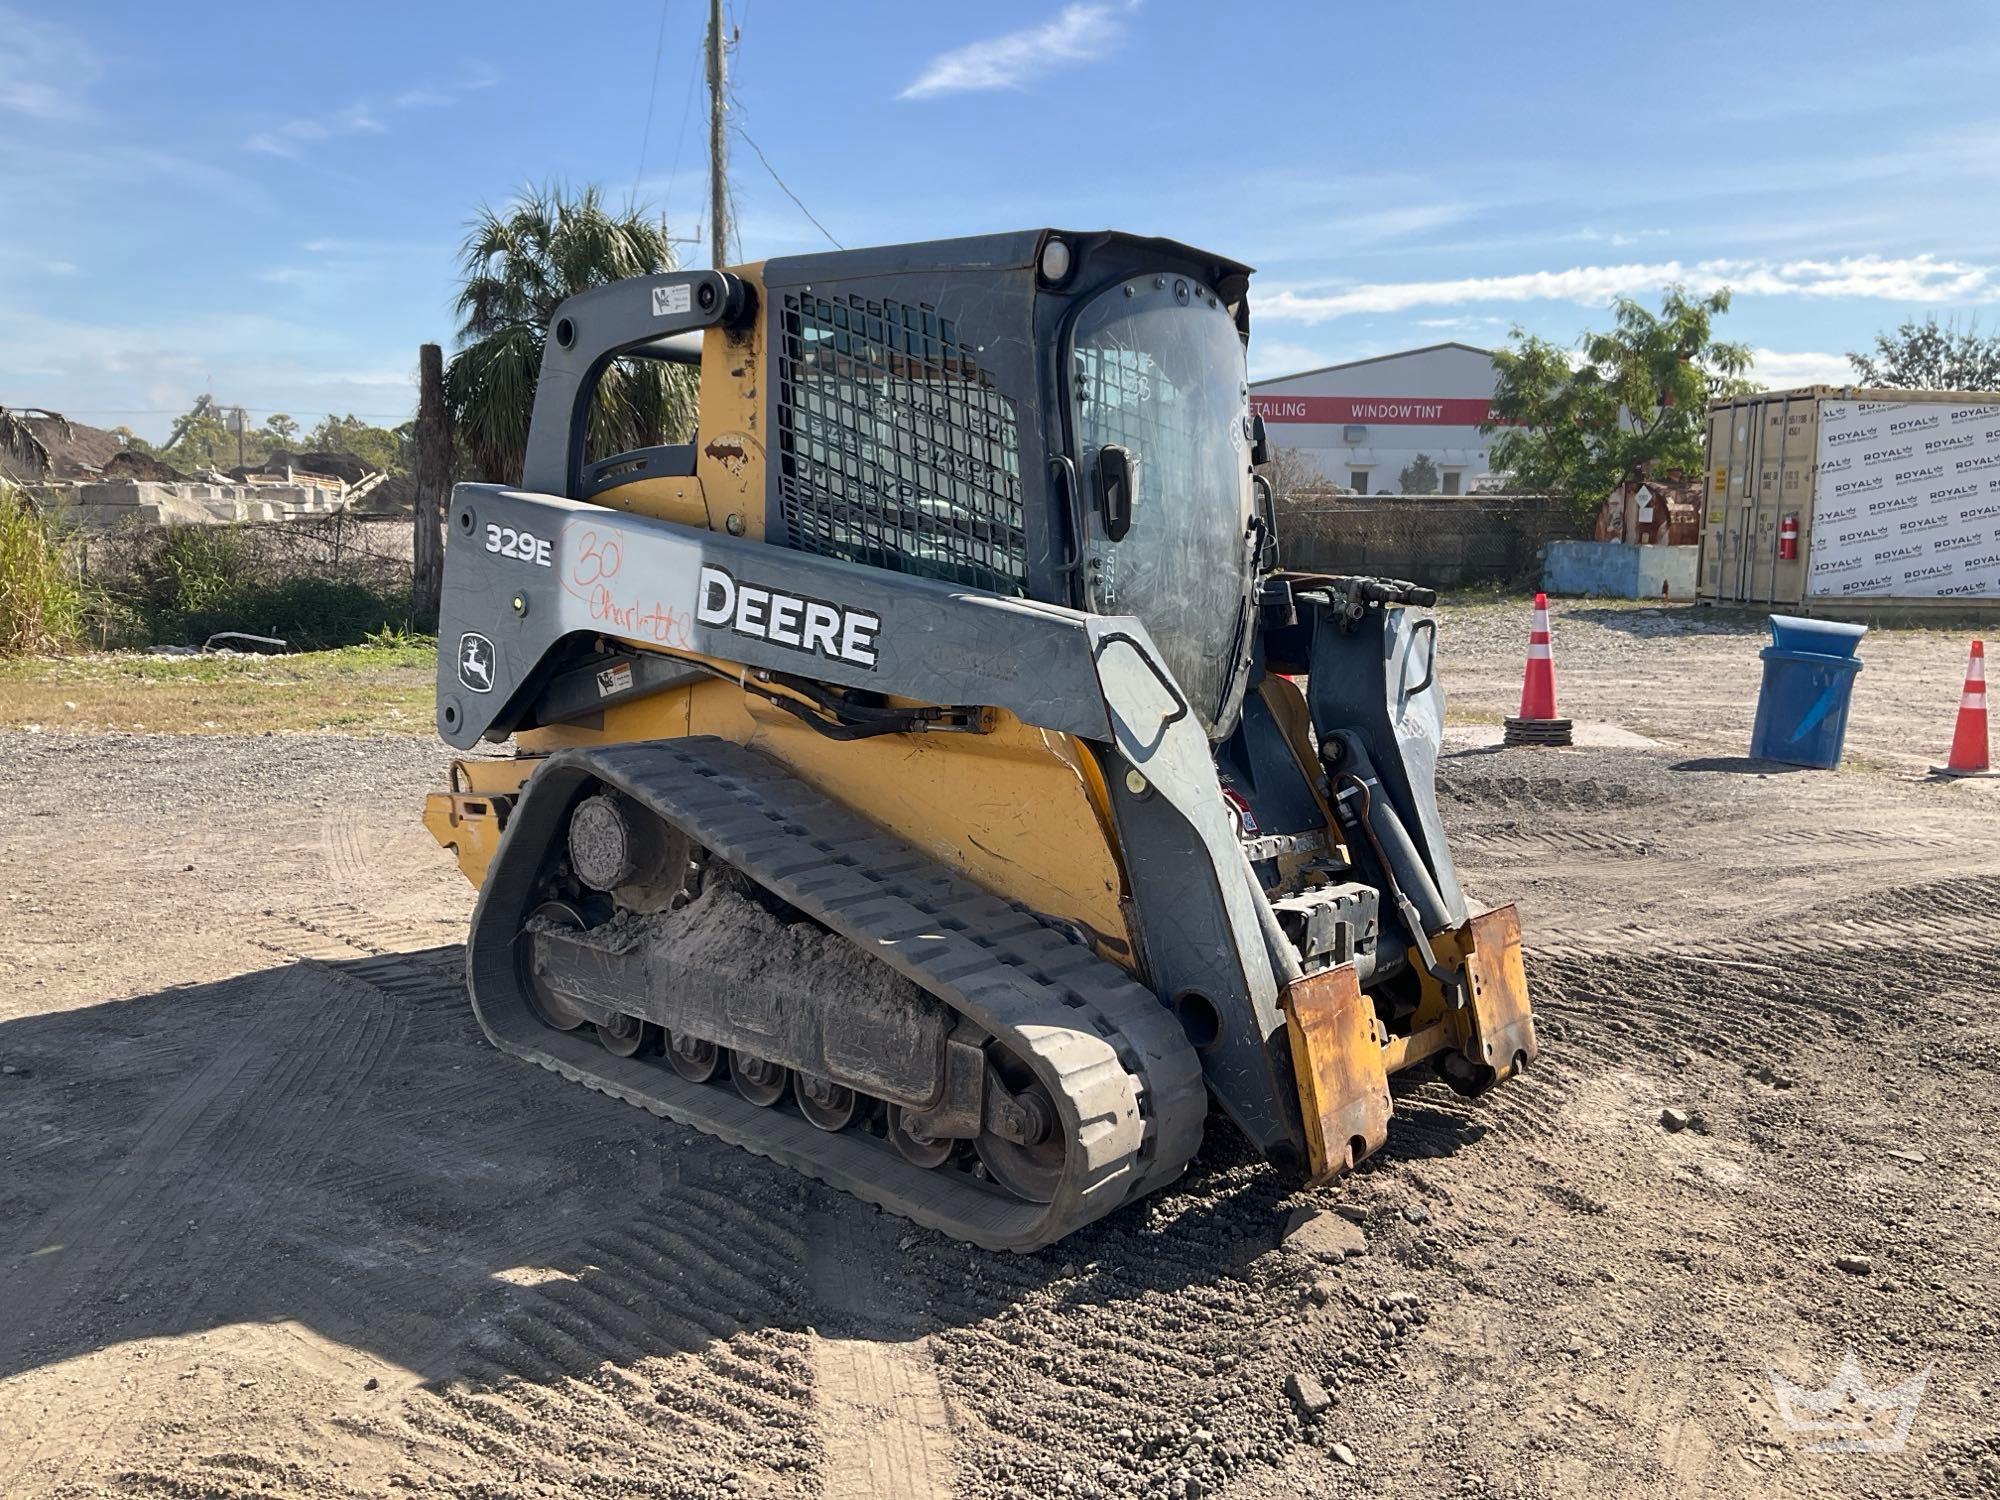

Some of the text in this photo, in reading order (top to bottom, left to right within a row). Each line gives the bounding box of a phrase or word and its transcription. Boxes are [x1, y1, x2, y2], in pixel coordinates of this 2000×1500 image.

[1352, 404, 1443, 418] WINDOW TINT
[1952, 407, 1990, 420] ROYAL
[1890, 418, 1928, 430] ROYAL
[1828, 430, 1867, 442] ROYAL
[1926, 438, 1963, 450] ROYAL
[1864, 449, 1902, 461] ROYAL
[1956, 456, 1994, 469] ROYAL
[1896, 468, 1933, 480] ROYAL
[1836, 480, 1872, 492] ROYAL
[1930, 486, 1968, 499] ROYAL
[1869, 498, 1907, 510] ROYAL
[1960, 506, 1997, 518] ROYAL
[1900, 518, 1937, 530] ROYAL
[1840, 529, 1877, 542] ROYAL
[485, 523, 552, 568] 329E
[1934, 536, 1972, 548] ROYAL
[573, 531, 621, 586] 30
[1875, 548, 1912, 560] ROYAL
[1904, 566, 1942, 578] ROYAL
[1843, 578, 1880, 590] ROYAL
[1937, 584, 1976, 596] ROYAL
[697, 566, 880, 667] DEERE
